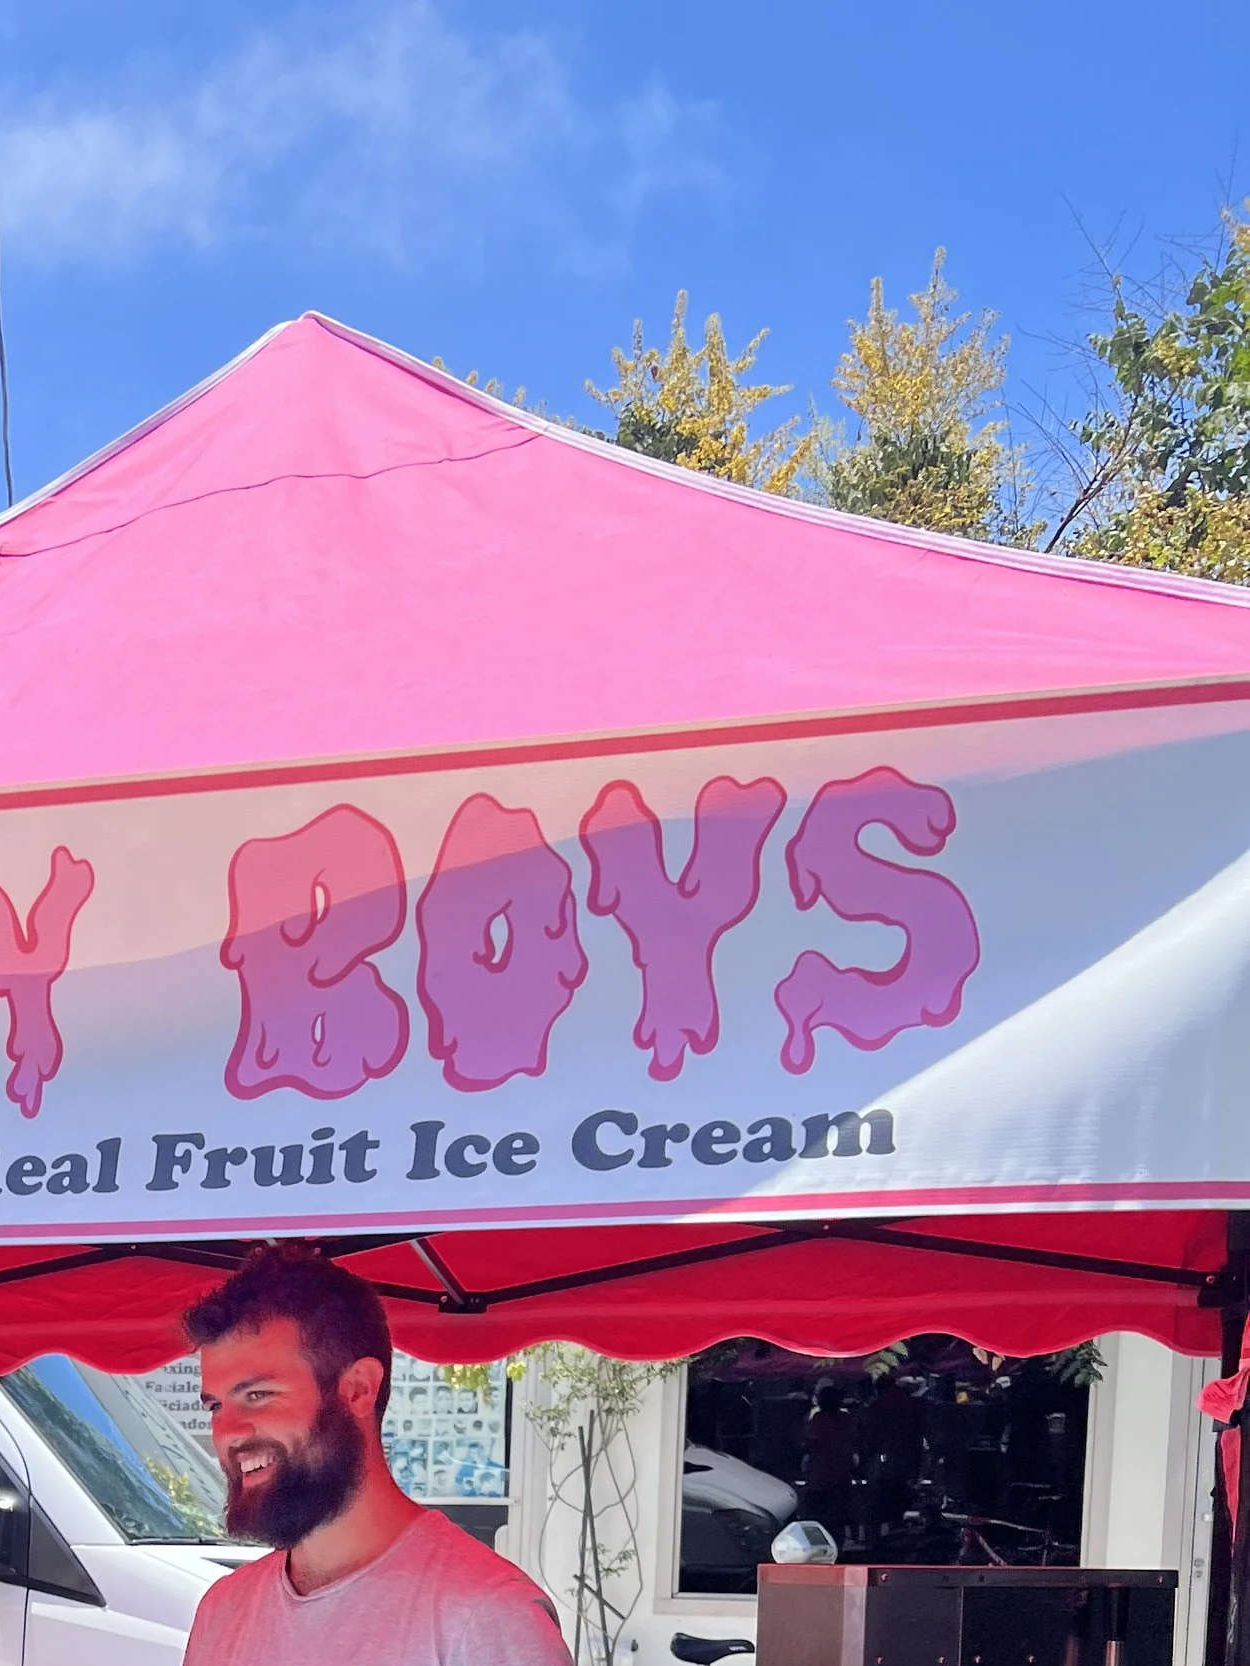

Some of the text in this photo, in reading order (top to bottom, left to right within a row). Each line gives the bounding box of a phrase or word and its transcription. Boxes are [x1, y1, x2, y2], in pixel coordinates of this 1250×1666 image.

[220, 766, 980, 1101] BOYS
[147, 1126, 379, 1192] Fruit
[405, 1121, 540, 1180] Ice
[571, 1109, 896, 1169] Cream
